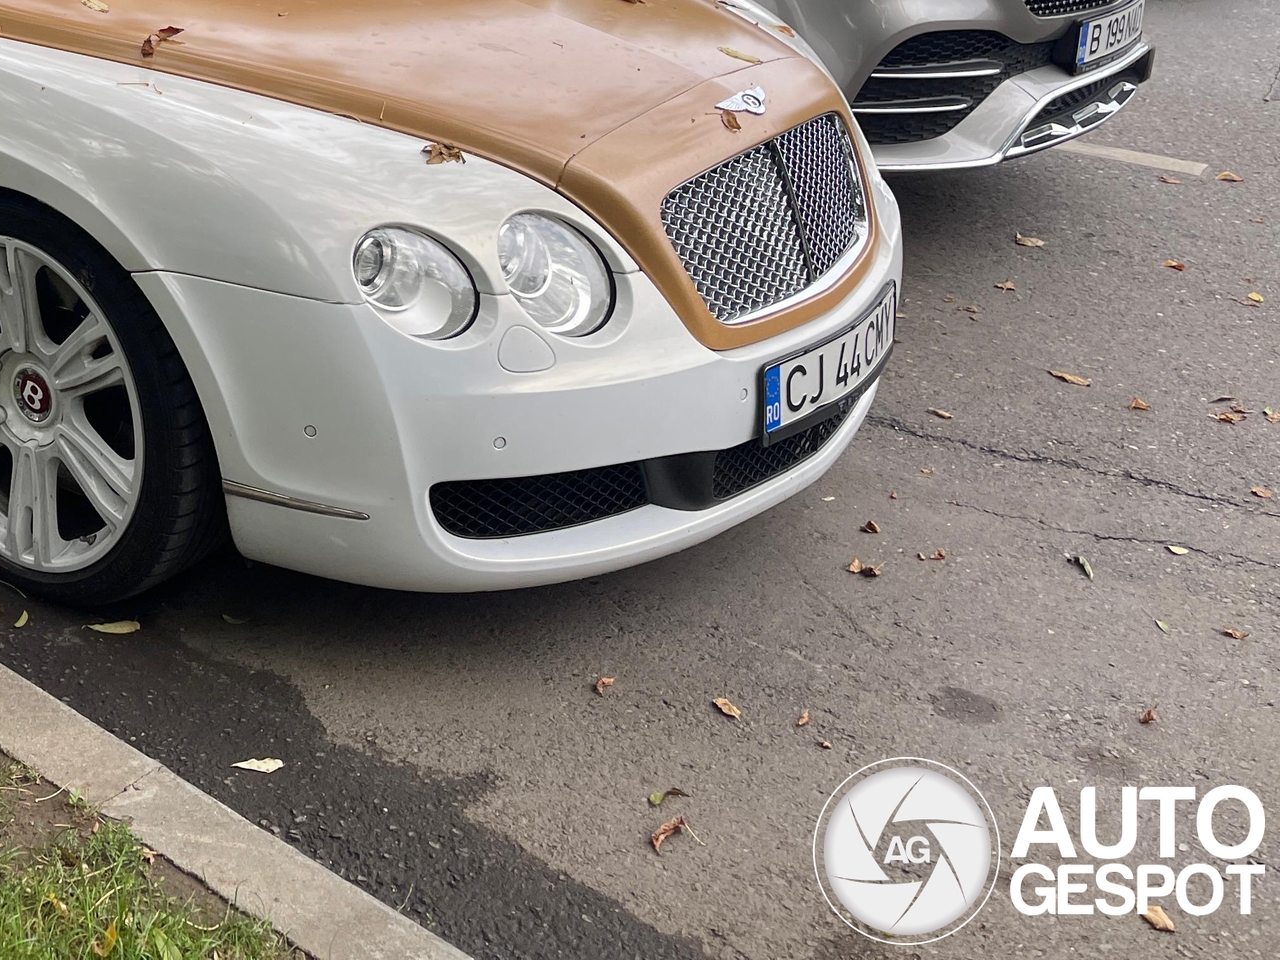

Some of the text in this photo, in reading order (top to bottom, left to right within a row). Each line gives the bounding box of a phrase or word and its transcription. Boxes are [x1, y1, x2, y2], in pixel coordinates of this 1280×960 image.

[786, 353, 824, 413] CJ
[835, 331, 861, 387] 44
[767, 401, 780, 425] RO
